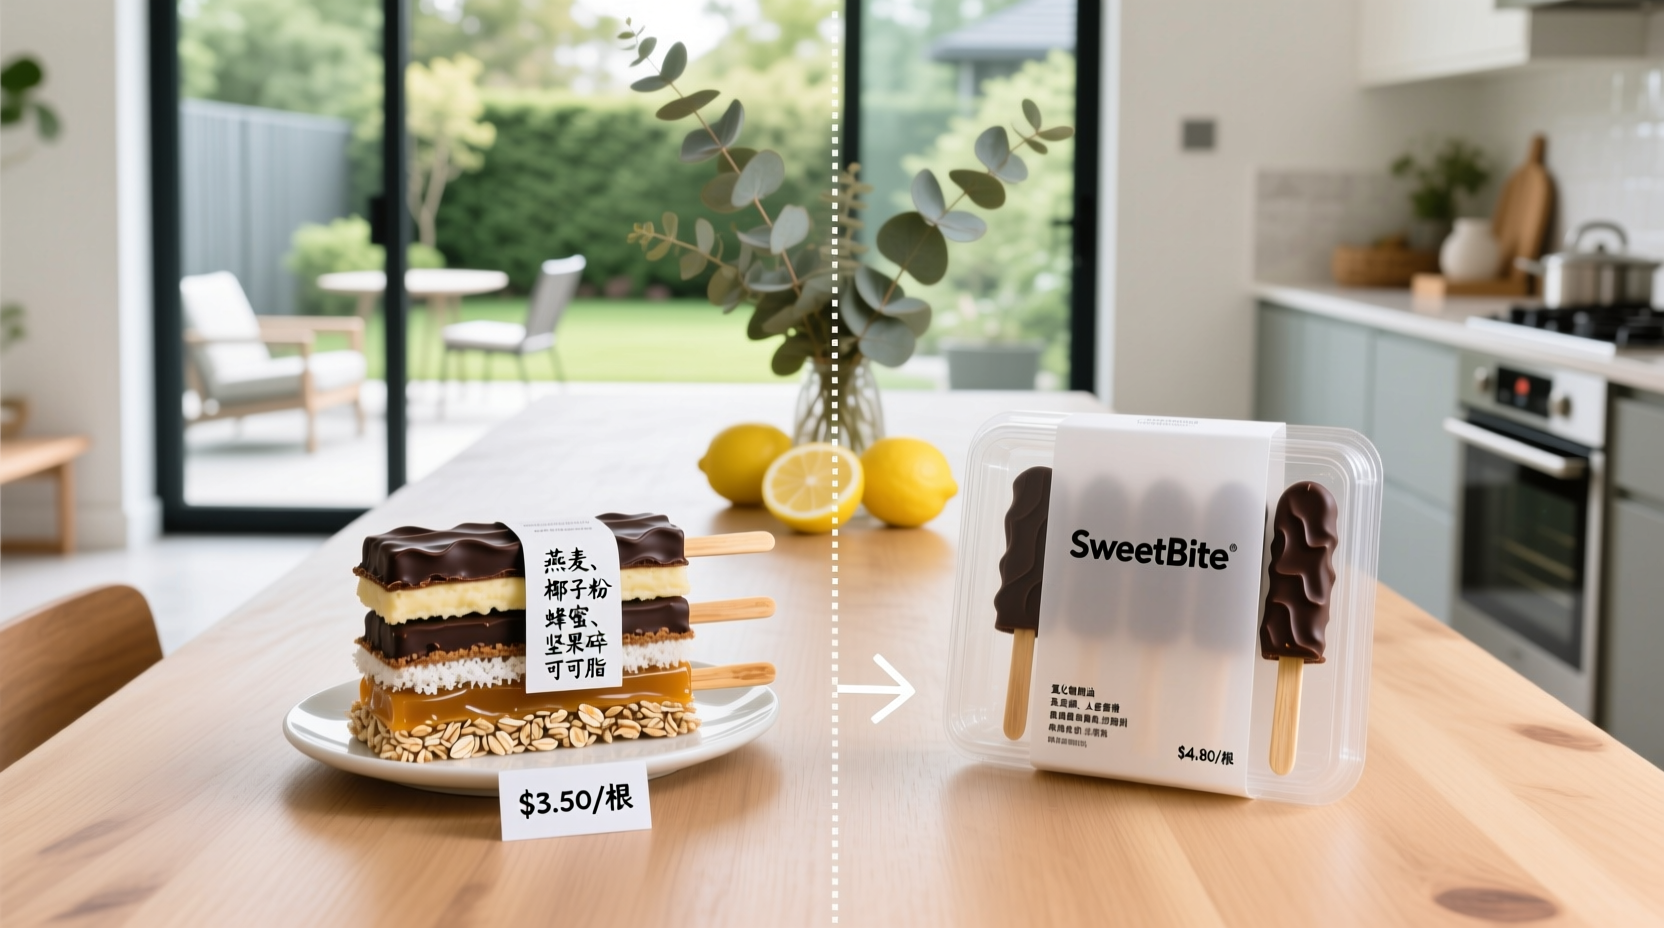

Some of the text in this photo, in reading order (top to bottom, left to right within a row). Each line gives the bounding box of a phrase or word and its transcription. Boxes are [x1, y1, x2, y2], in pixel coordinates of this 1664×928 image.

[544, 547, 597, 574] 燕麦、
[544, 577, 612, 601] 椰子粉
[545, 604, 598, 630] 蜂蜜、
[545, 630, 608, 656] 坚果碎
[545, 657, 606, 680] 可可脂
[1177, 745, 1234, 765] $4.80/根
[519, 783, 634, 819] $3.50/根
